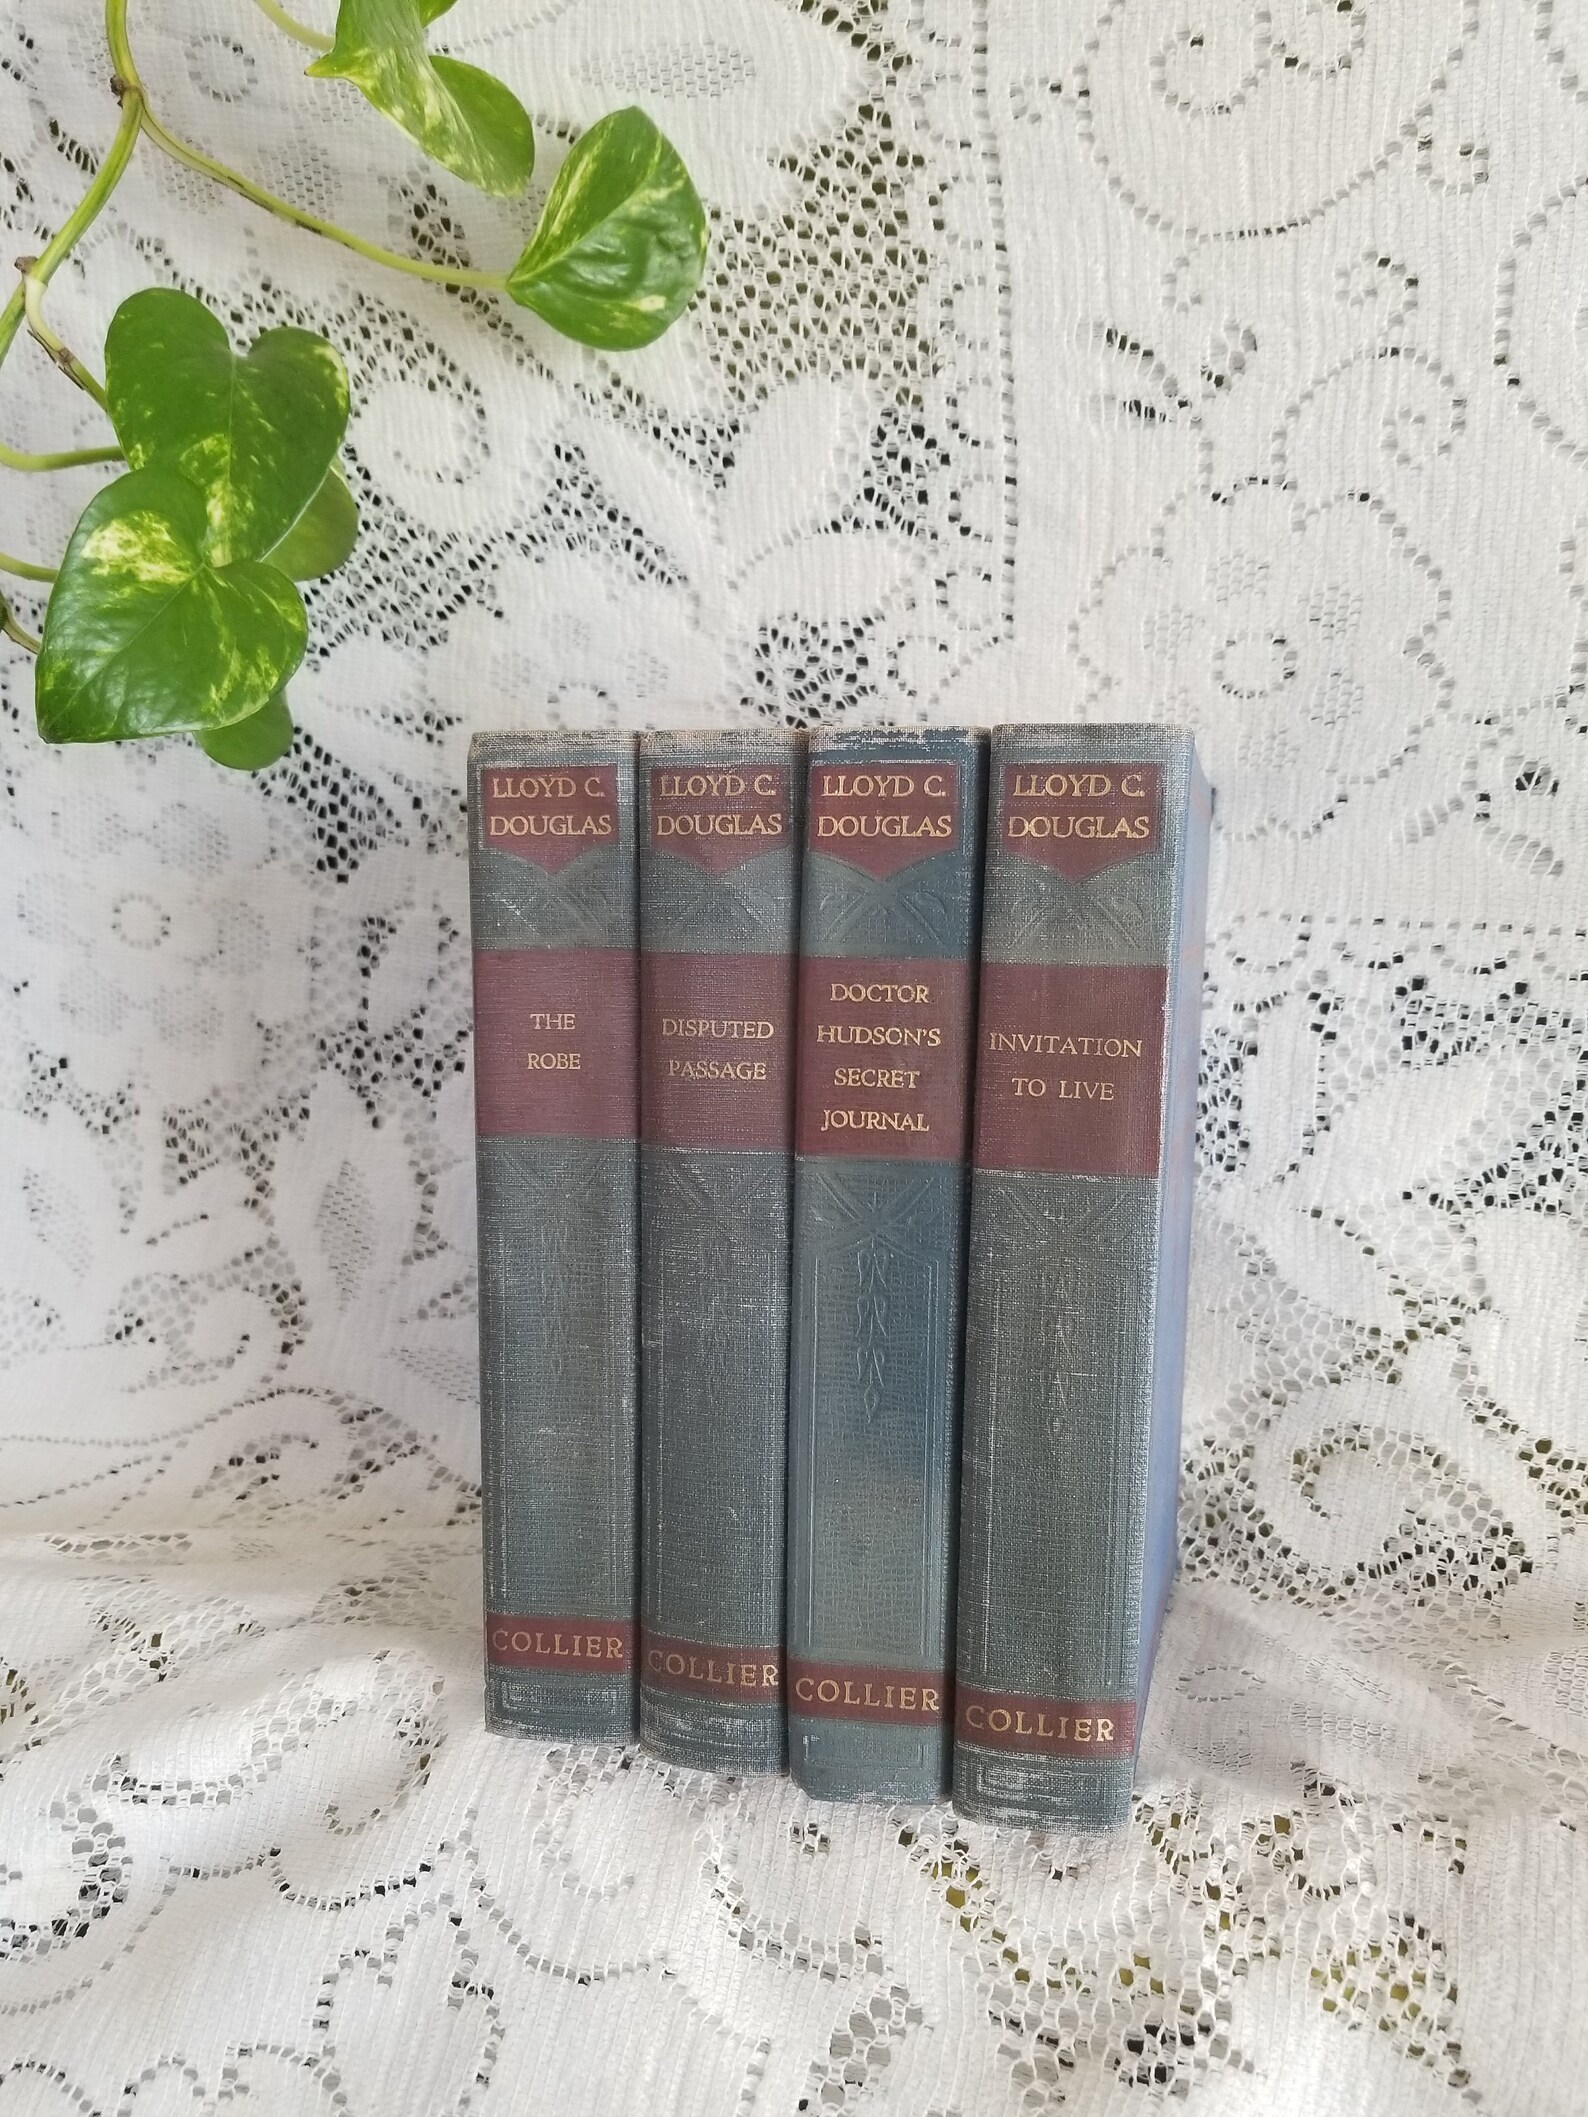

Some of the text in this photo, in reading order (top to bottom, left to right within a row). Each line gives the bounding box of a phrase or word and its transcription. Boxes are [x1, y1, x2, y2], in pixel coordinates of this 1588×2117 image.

[492, 777, 605, 799] LLOYD C.
[659, 774, 777, 797] LLOYD C.
[821, 775, 946, 798] LLOYD C.
[1013, 774, 1145, 798] LLOYD C.
[490, 814, 612, 836] DOUGLAS
[656, 813, 782, 836] DOUGLAS
[816, 815, 952, 838] DOUGLAS
[1007, 815, 1150, 839] DOUGLAS
[829, 983, 930, 1003] DOCTOR
[530, 1013, 576, 1031] THE
[661, 1017, 774, 1039] DISPUTED
[816, 1024, 941, 1047] HUDSON'S
[988, 1031, 1143, 1058] INVITATION
[527, 1053, 581, 1070] ROBE
[668, 1060, 767, 1081] PASSAGE
[833, 1067, 920, 1089] SECRET
[1011, 1077, 1115, 1101] TO LIVE
[820, 1109, 930, 1132] JOURNAL
[492, 1629, 624, 1659] COLLIER
[649, 1649, 780, 1687] COLLIER
[795, 1677, 940, 1711] COLLIER
[965, 1705, 1116, 1743] COLLIER
